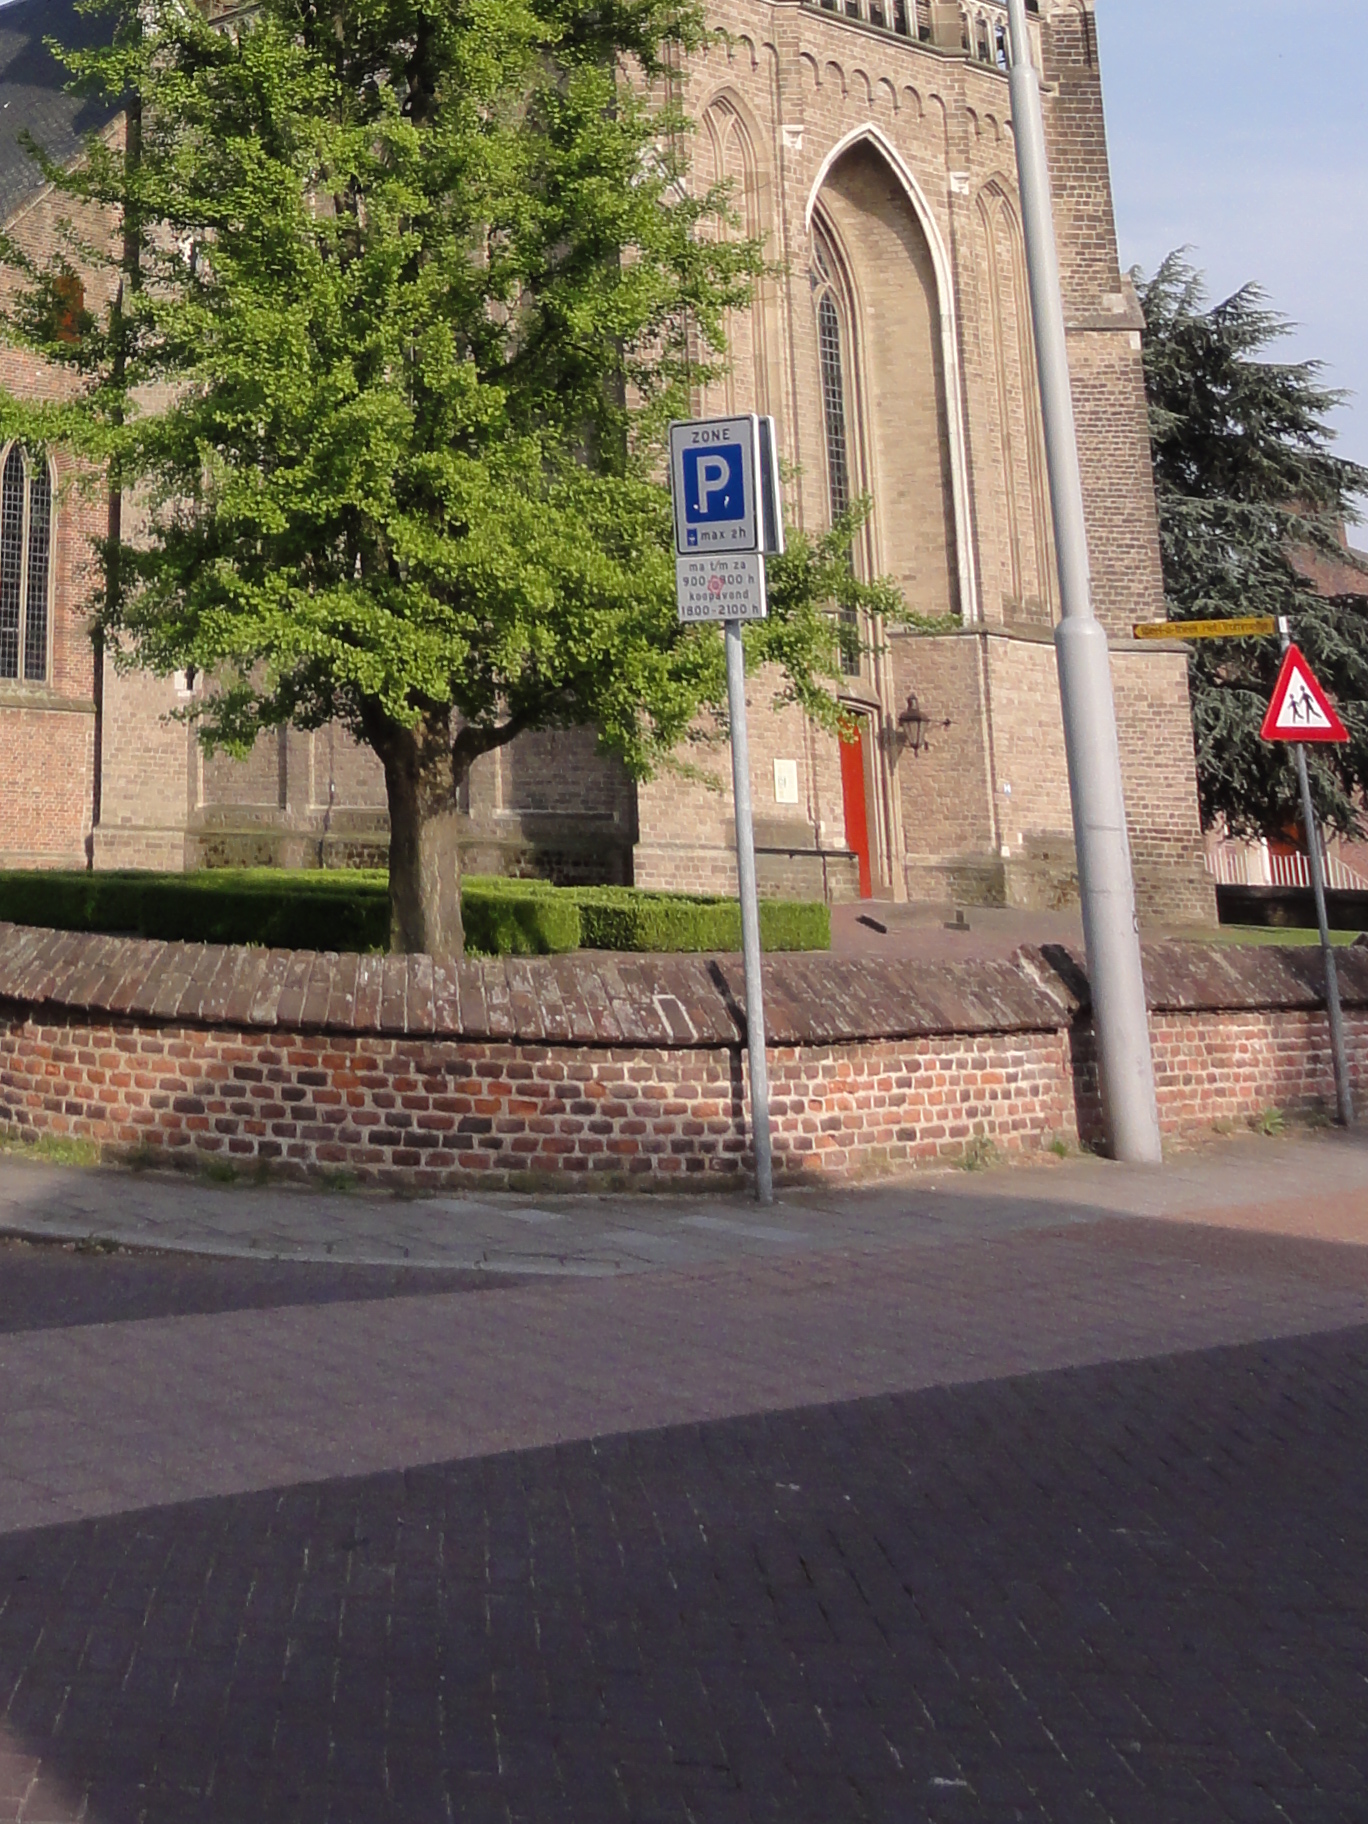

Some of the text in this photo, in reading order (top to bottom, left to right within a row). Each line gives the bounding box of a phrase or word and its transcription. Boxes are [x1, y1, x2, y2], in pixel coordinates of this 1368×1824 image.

[692, 428, 730, 443] ZONE
[696, 455, 730, 513] P
[701, 530, 725, 540] max
[689, 560, 746, 571] ma t/m za
[748, 574, 754, 584] h
[689, 589, 749, 603] koopavond
[752, 604, 759, 613] h
